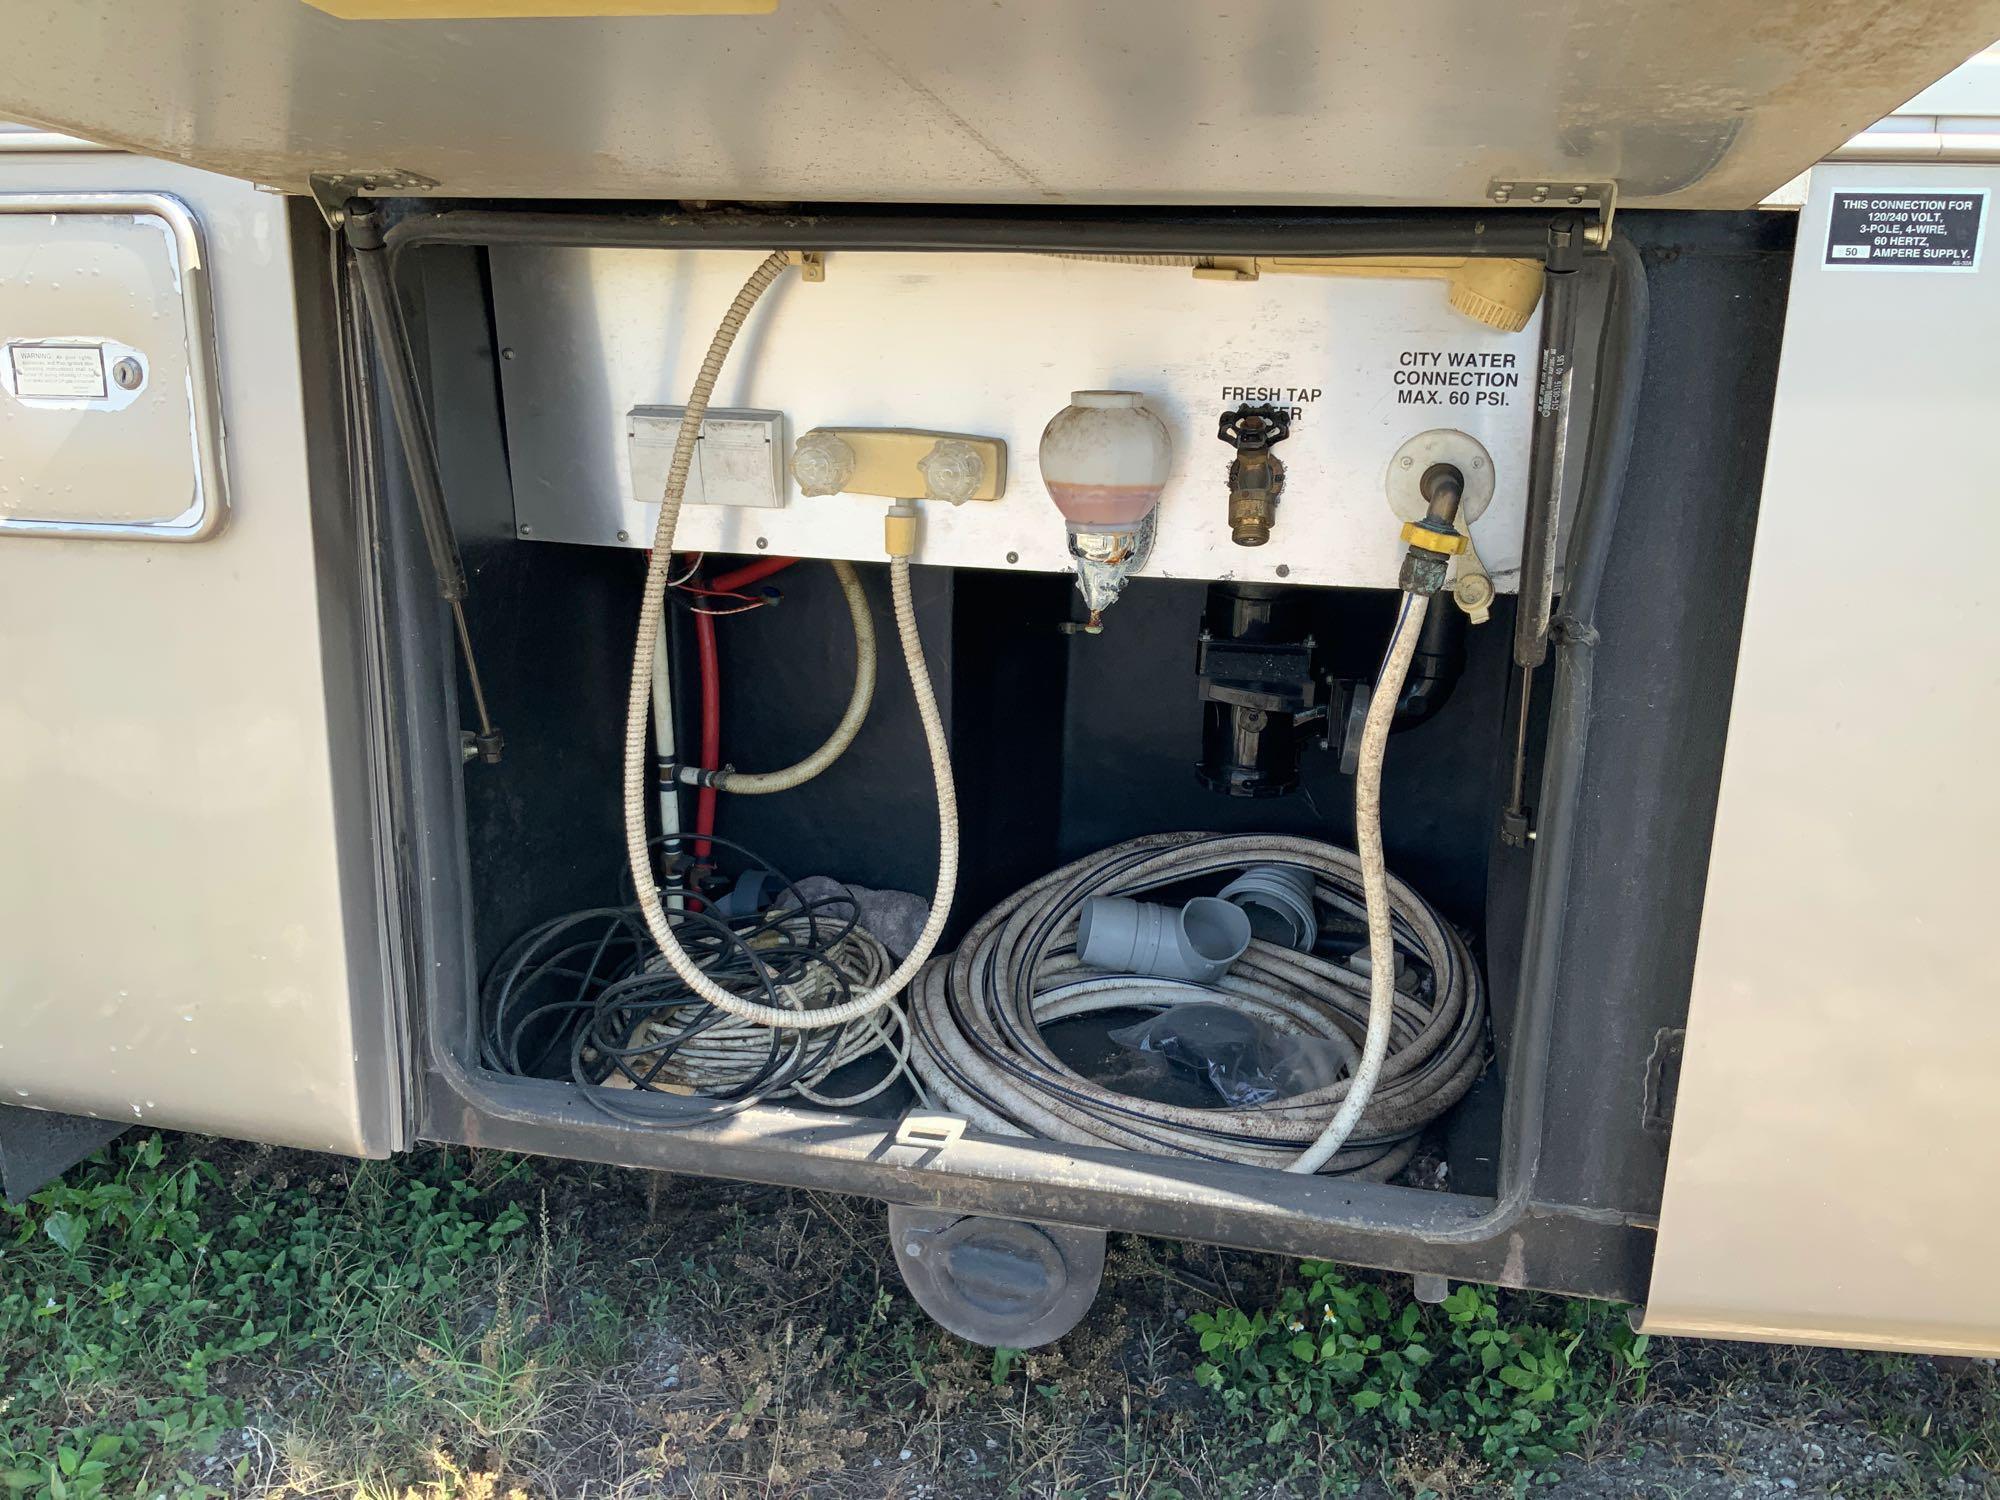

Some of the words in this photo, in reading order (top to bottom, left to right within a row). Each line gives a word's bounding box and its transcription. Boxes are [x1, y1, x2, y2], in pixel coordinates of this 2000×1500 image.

[1843, 200, 1868, 209] THIS
[1871, 200, 1946, 210] CONNECTION
[1948, 201, 1973, 210] FOR
[1868, 212, 1908, 222] 120/240
[1911, 213, 1944, 223] VOLT,
[1860, 224, 1902, 235] 3-POLE,
[1905, 225, 1947, 235] 4-WIRE,
[1874, 236, 1887, 245] 60
[1889, 236, 1929, 247] HERTZ,
[1845, 247, 1858, 256] 50
[1872, 248, 1921, 258] AMPERE
[1923, 249, 1971, 258] SUPPLY.
[1400, 352, 1442, 366] CITY
[1448, 353, 1516, 368] WATER
[1393, 371, 1519, 387] CONNECTION
[1222, 386, 1281, 401] FRESH
[1286, 388, 1322, 402] TAP
[1398, 390, 1442, 405] MAX.
[1449, 391, 1470, 405] 60
[1475, 392, 1509, 406] PSI.
